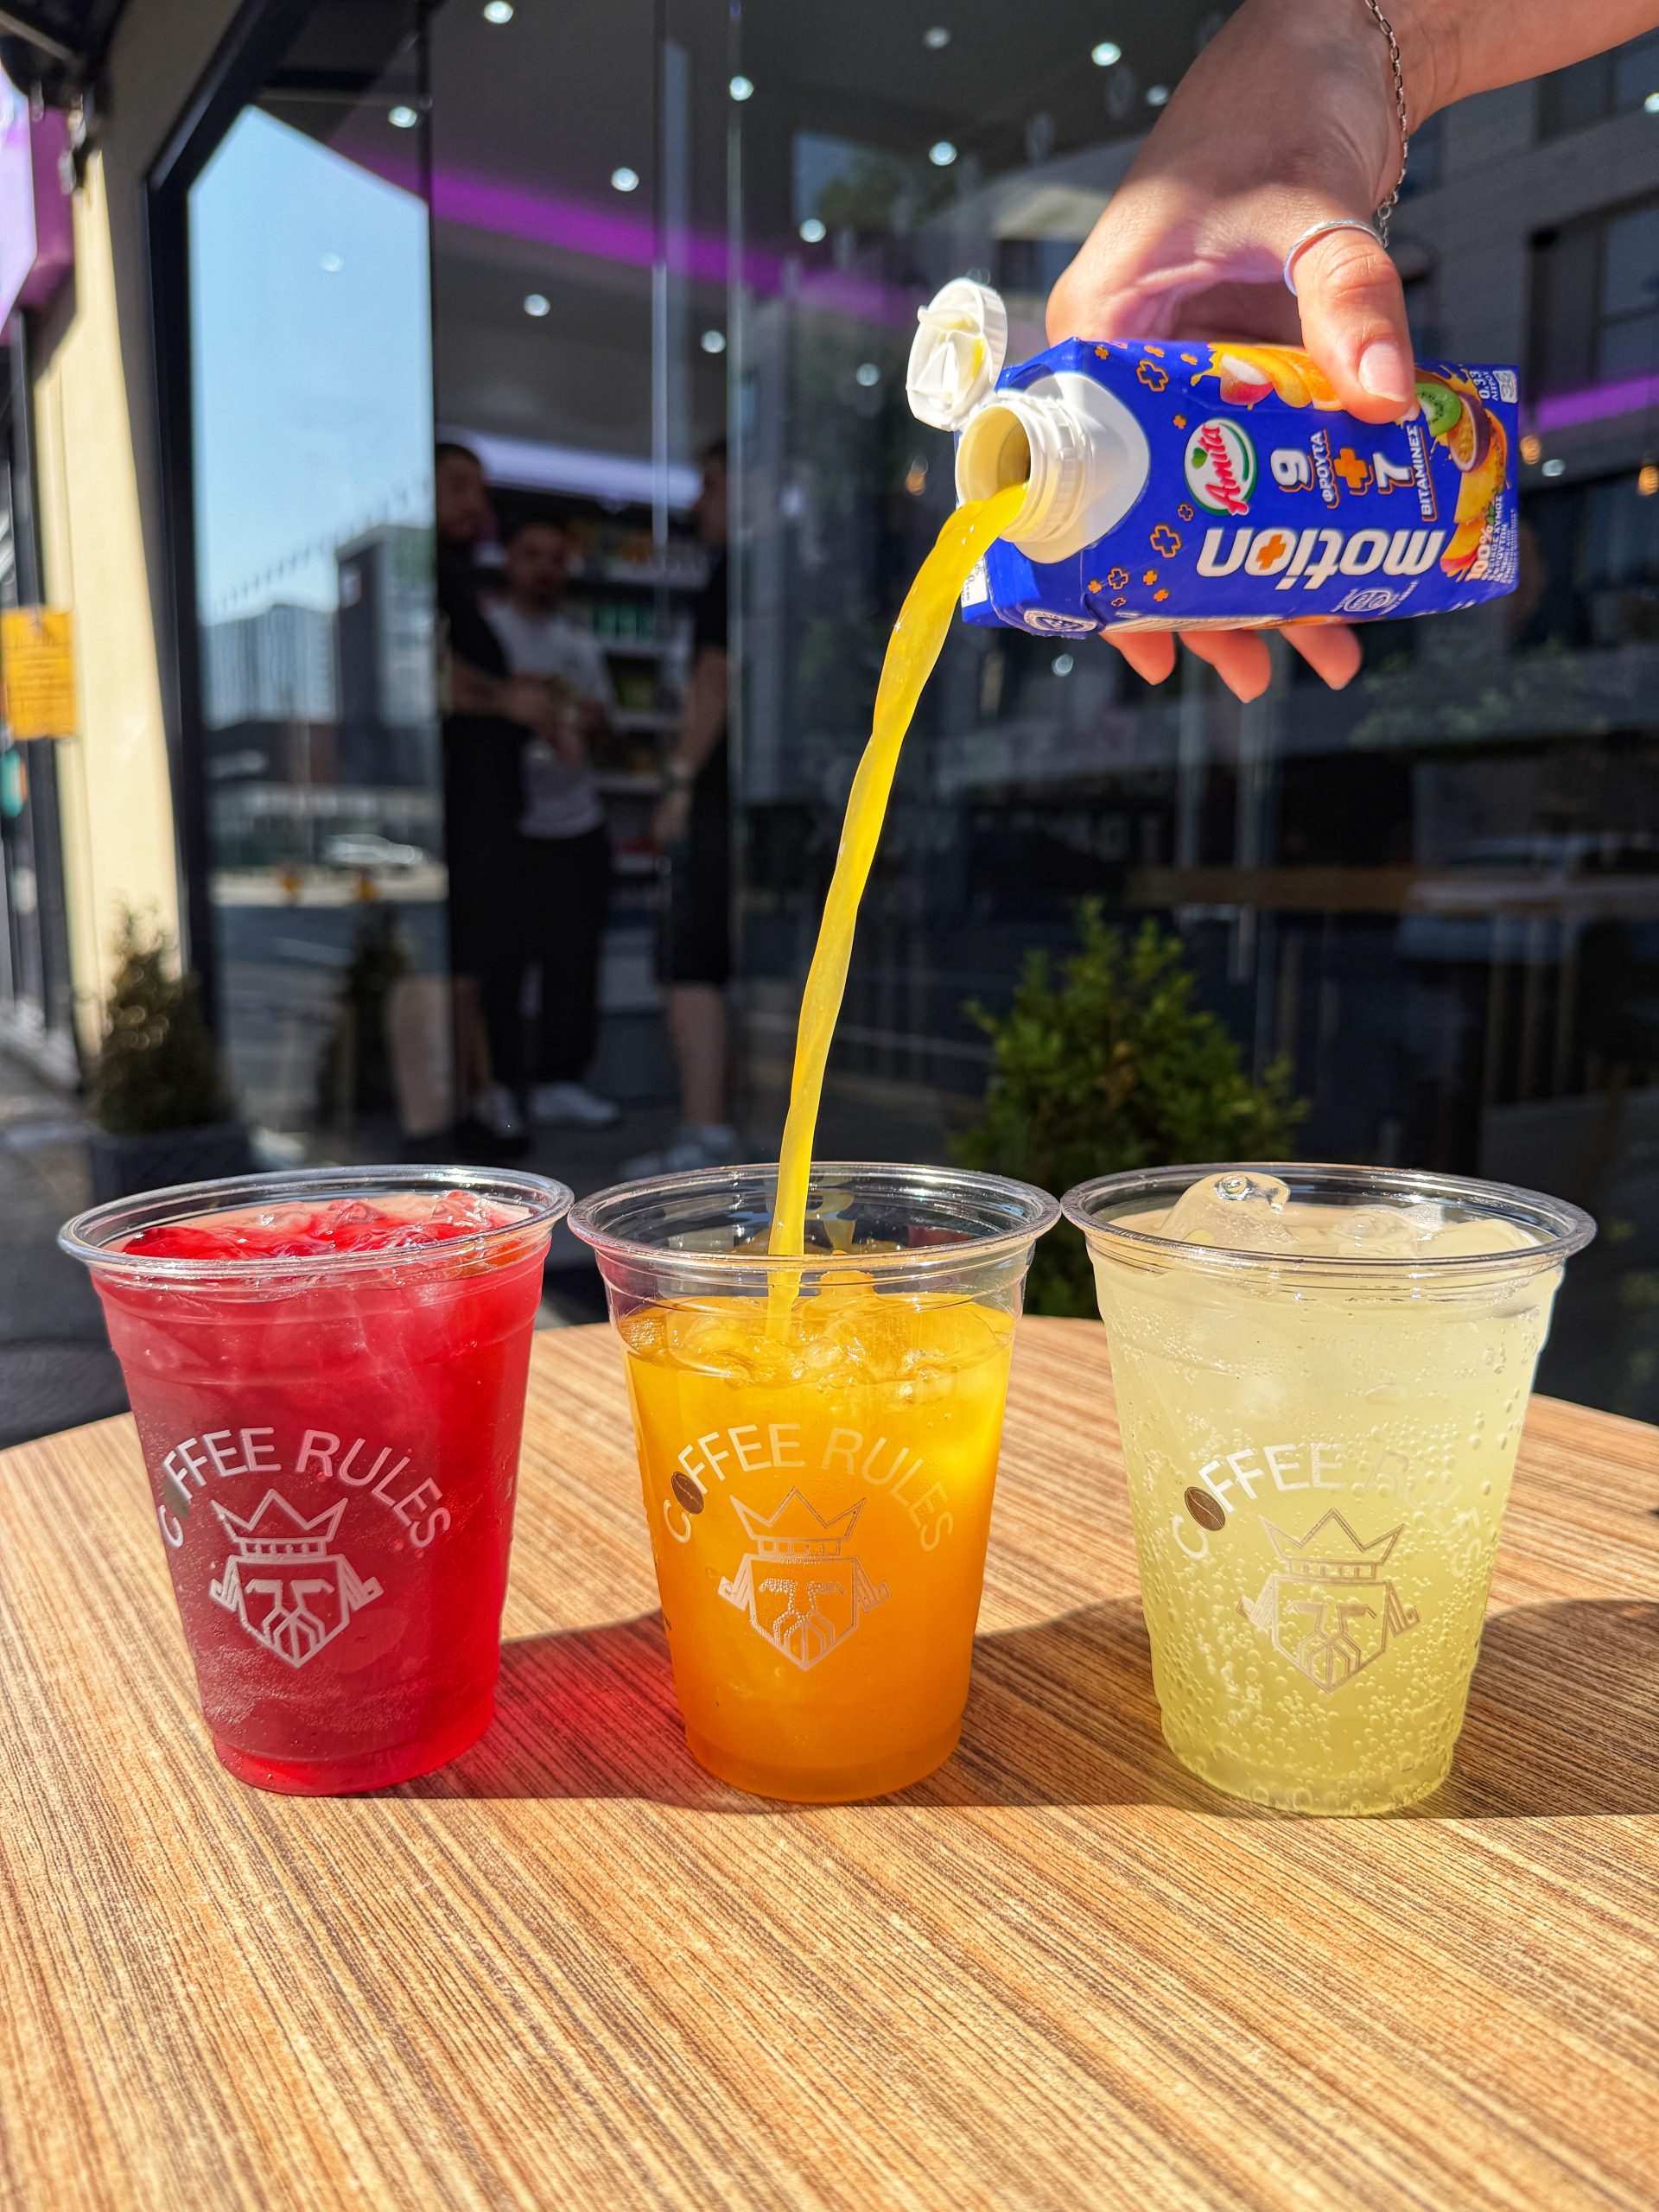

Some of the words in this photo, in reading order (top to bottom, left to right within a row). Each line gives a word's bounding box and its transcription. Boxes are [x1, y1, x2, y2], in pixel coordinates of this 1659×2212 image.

[1201, 423, 1249, 516] Amita
[1270, 448, 1312, 489] 9
[1310, 429, 1338, 505] ΦΡΟΥΤΑ
[1372, 452, 1413, 491] 7
[1406, 424, 1435, 518] ΒΙΤΑΜΙΝΕΣ
[1196, 527, 1445, 590] motion
[1464, 524, 1493, 582] 100%
[296, 1429, 451, 1548] RULES
[822, 1427, 954, 1551] RULES
